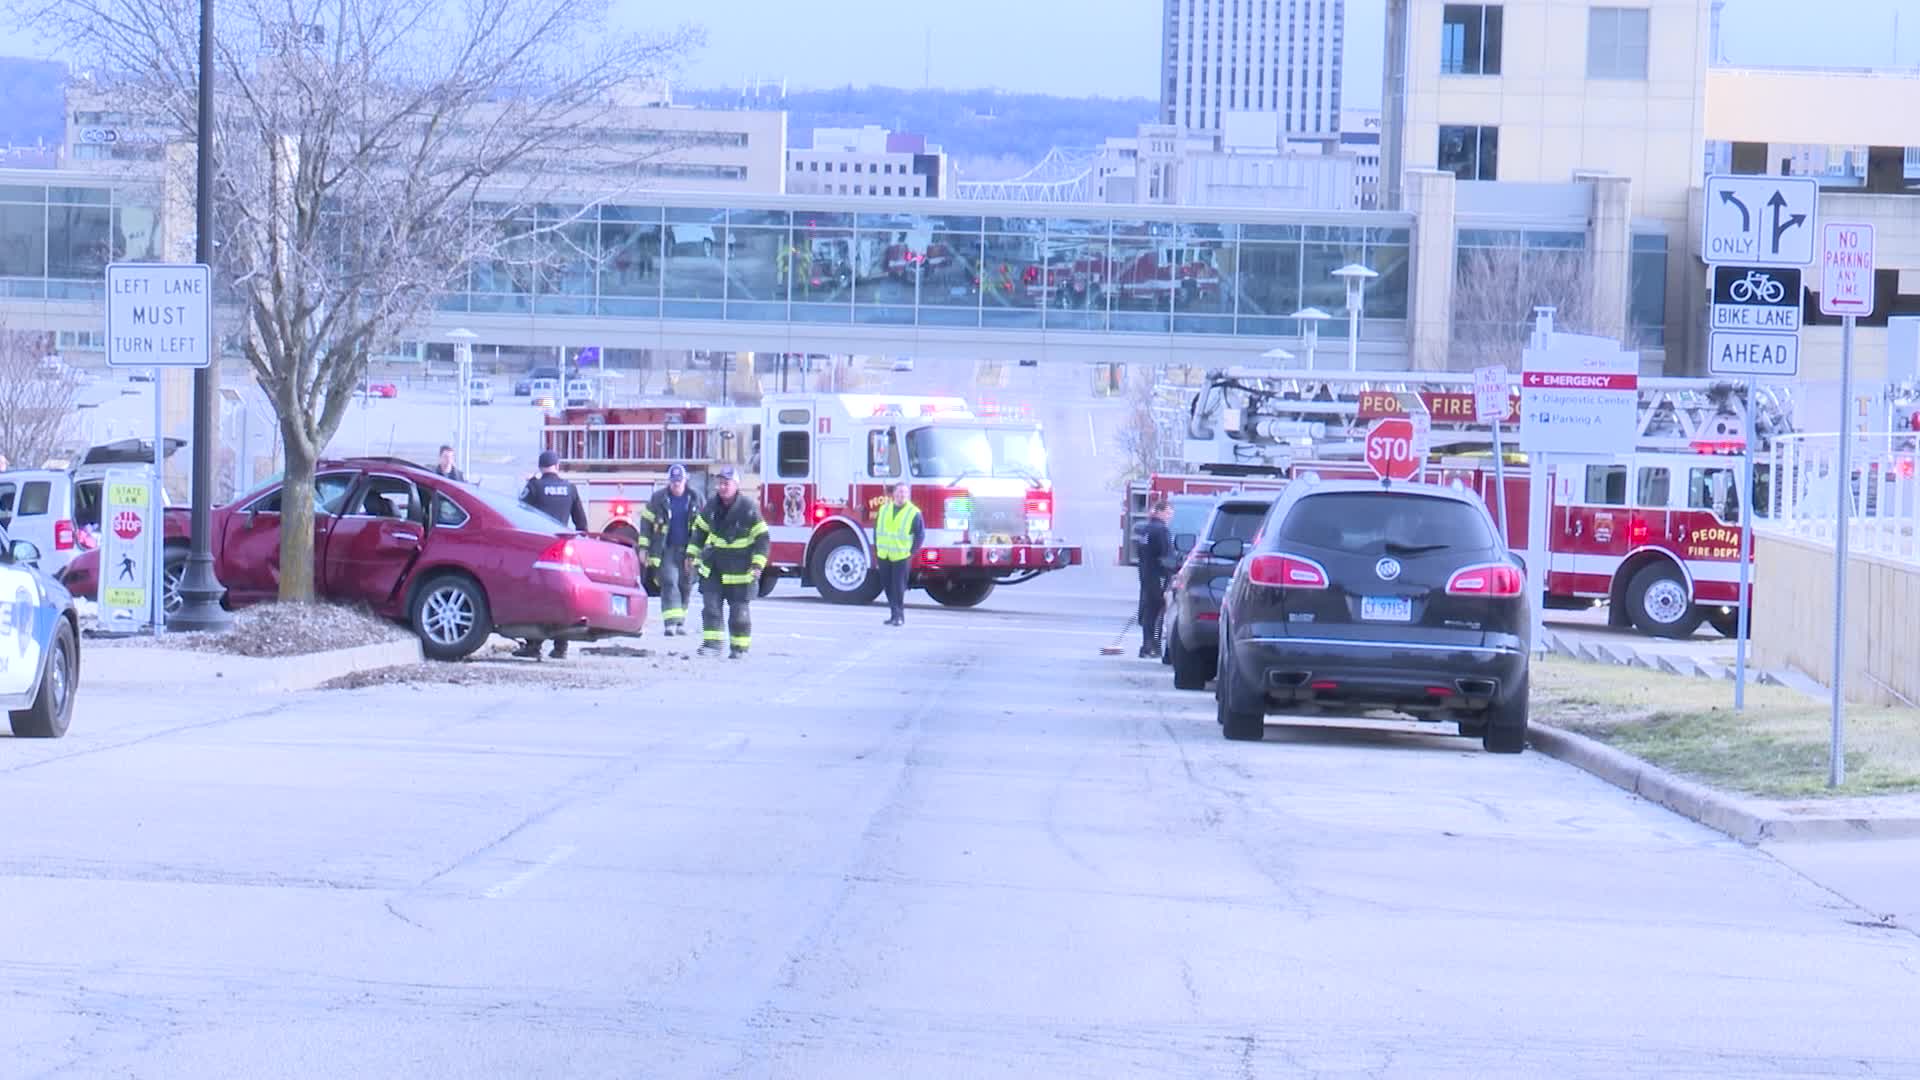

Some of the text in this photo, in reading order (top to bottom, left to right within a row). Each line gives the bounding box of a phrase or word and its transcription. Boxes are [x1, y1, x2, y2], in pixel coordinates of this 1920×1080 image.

[1712, 238, 1753, 253] ONLY
[1839, 232, 1857, 248] NO
[1826, 251, 1869, 268] PARKING
[1838, 271, 1856, 281] ANY
[115, 279, 202, 294] LEFT LANE
[1836, 284, 1857, 295] TIME
[133, 306, 185, 325] MUST
[1718, 308, 1793, 326] BIKE LANE
[115, 337, 195, 352] TURN LEFT
[1721, 344, 1787, 364] AHEAD
[1543, 375, 1610, 387] EMERGENCY
[1432, 398, 1472, 415] FIRE
[1543, 393, 1631, 407] Diagnostic Center
[1552, 413, 1592, 425] Parking
[1594, 415, 1602, 424] A
[116, 487, 141, 496] STATE
[114, 521, 141, 532] STOP
[1691, 528, 1739, 546] PEORIA
[1018, 548, 1026, 565] 1
[1688, 546, 1740, 559] FIRE DEPT.
